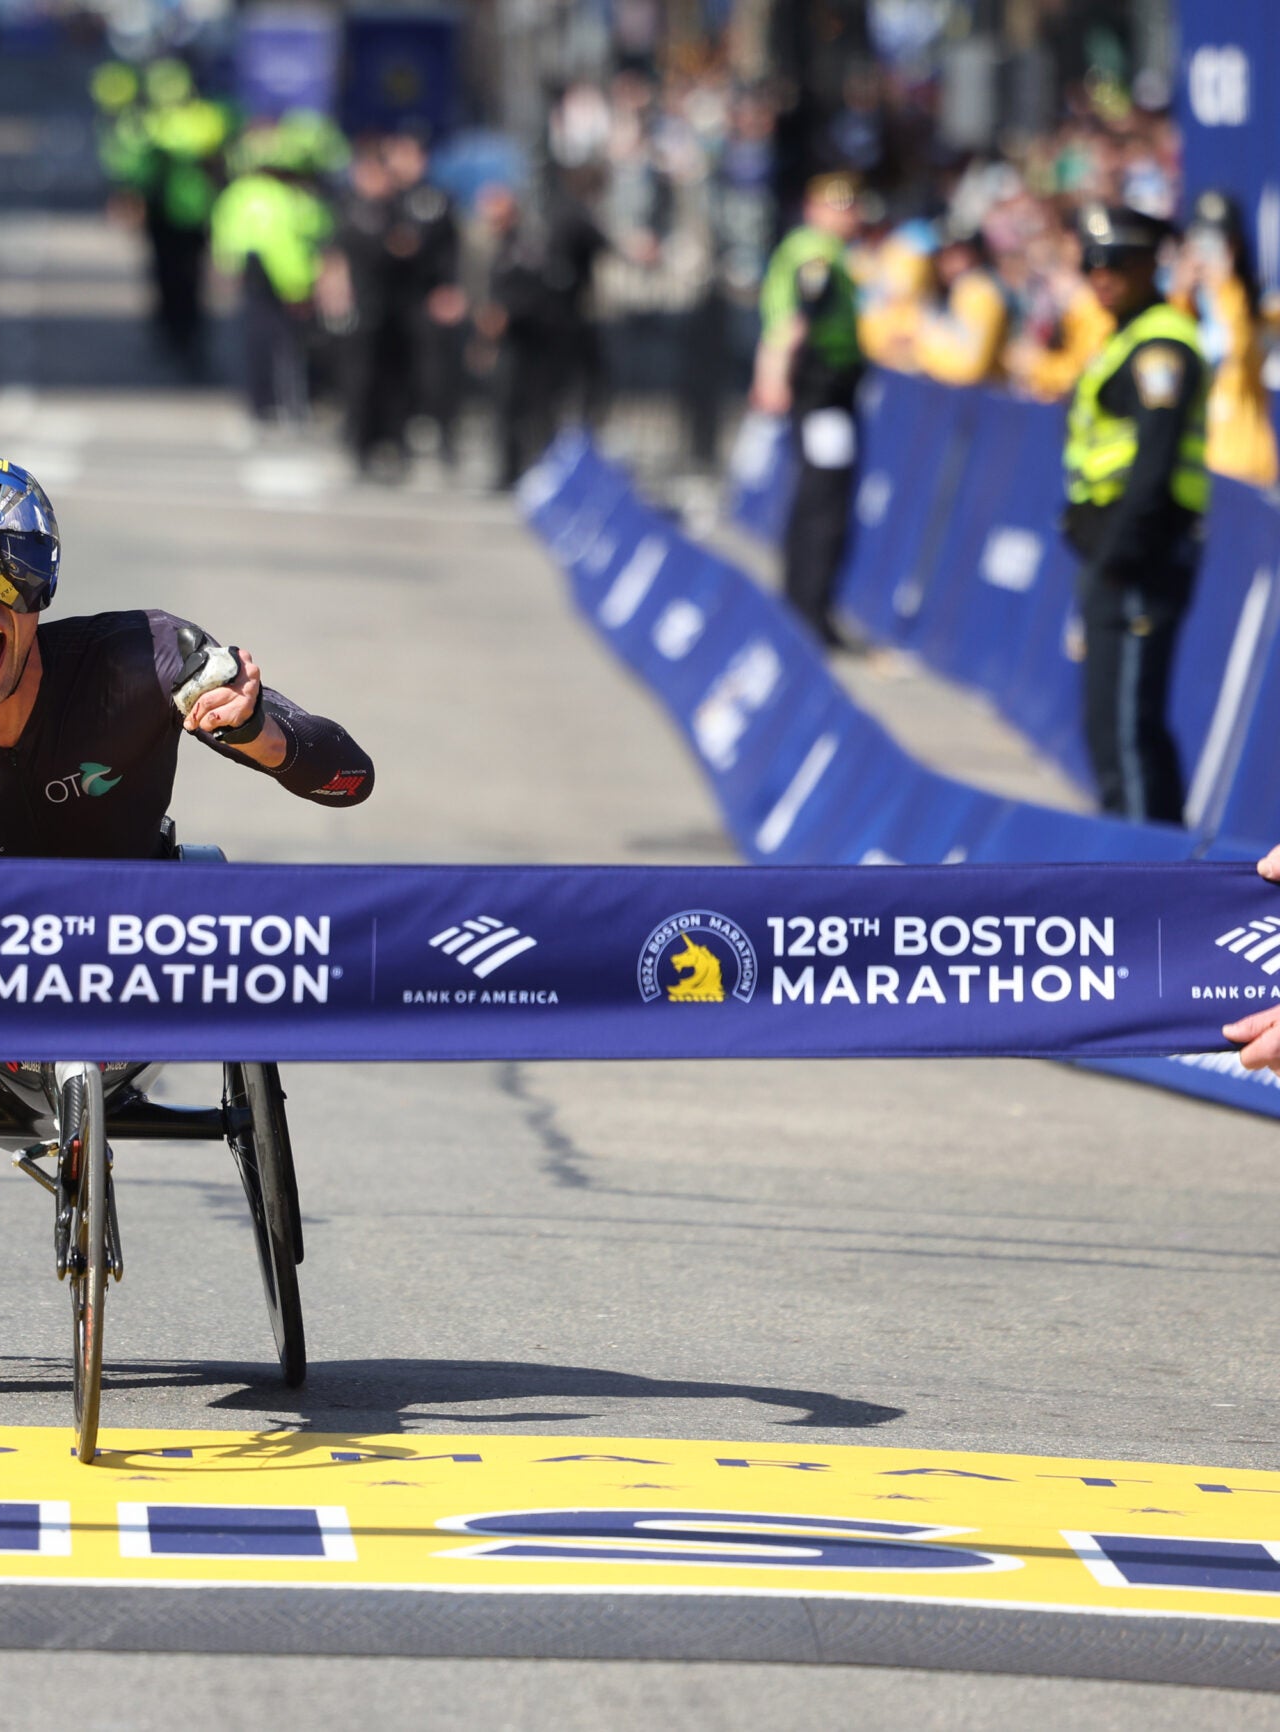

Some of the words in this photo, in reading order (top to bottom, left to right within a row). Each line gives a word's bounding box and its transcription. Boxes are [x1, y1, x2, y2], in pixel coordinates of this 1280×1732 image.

[108, 914, 331, 956] BOSTON
[641, 956, 655, 995] 2024
[648, 914, 701, 954] BOSTON
[709, 916, 754, 992] MARATHON
[767, 916, 880, 957] 128TH
[894, 916, 1114, 957] BOSTON
[403, 990, 450, 1004] BANK
[454, 990, 476, 1004] OF
[480, 990, 559, 1004] AMERICA
[1191, 985, 1239, 999] BANK
[1243, 985, 1266, 999] OF
